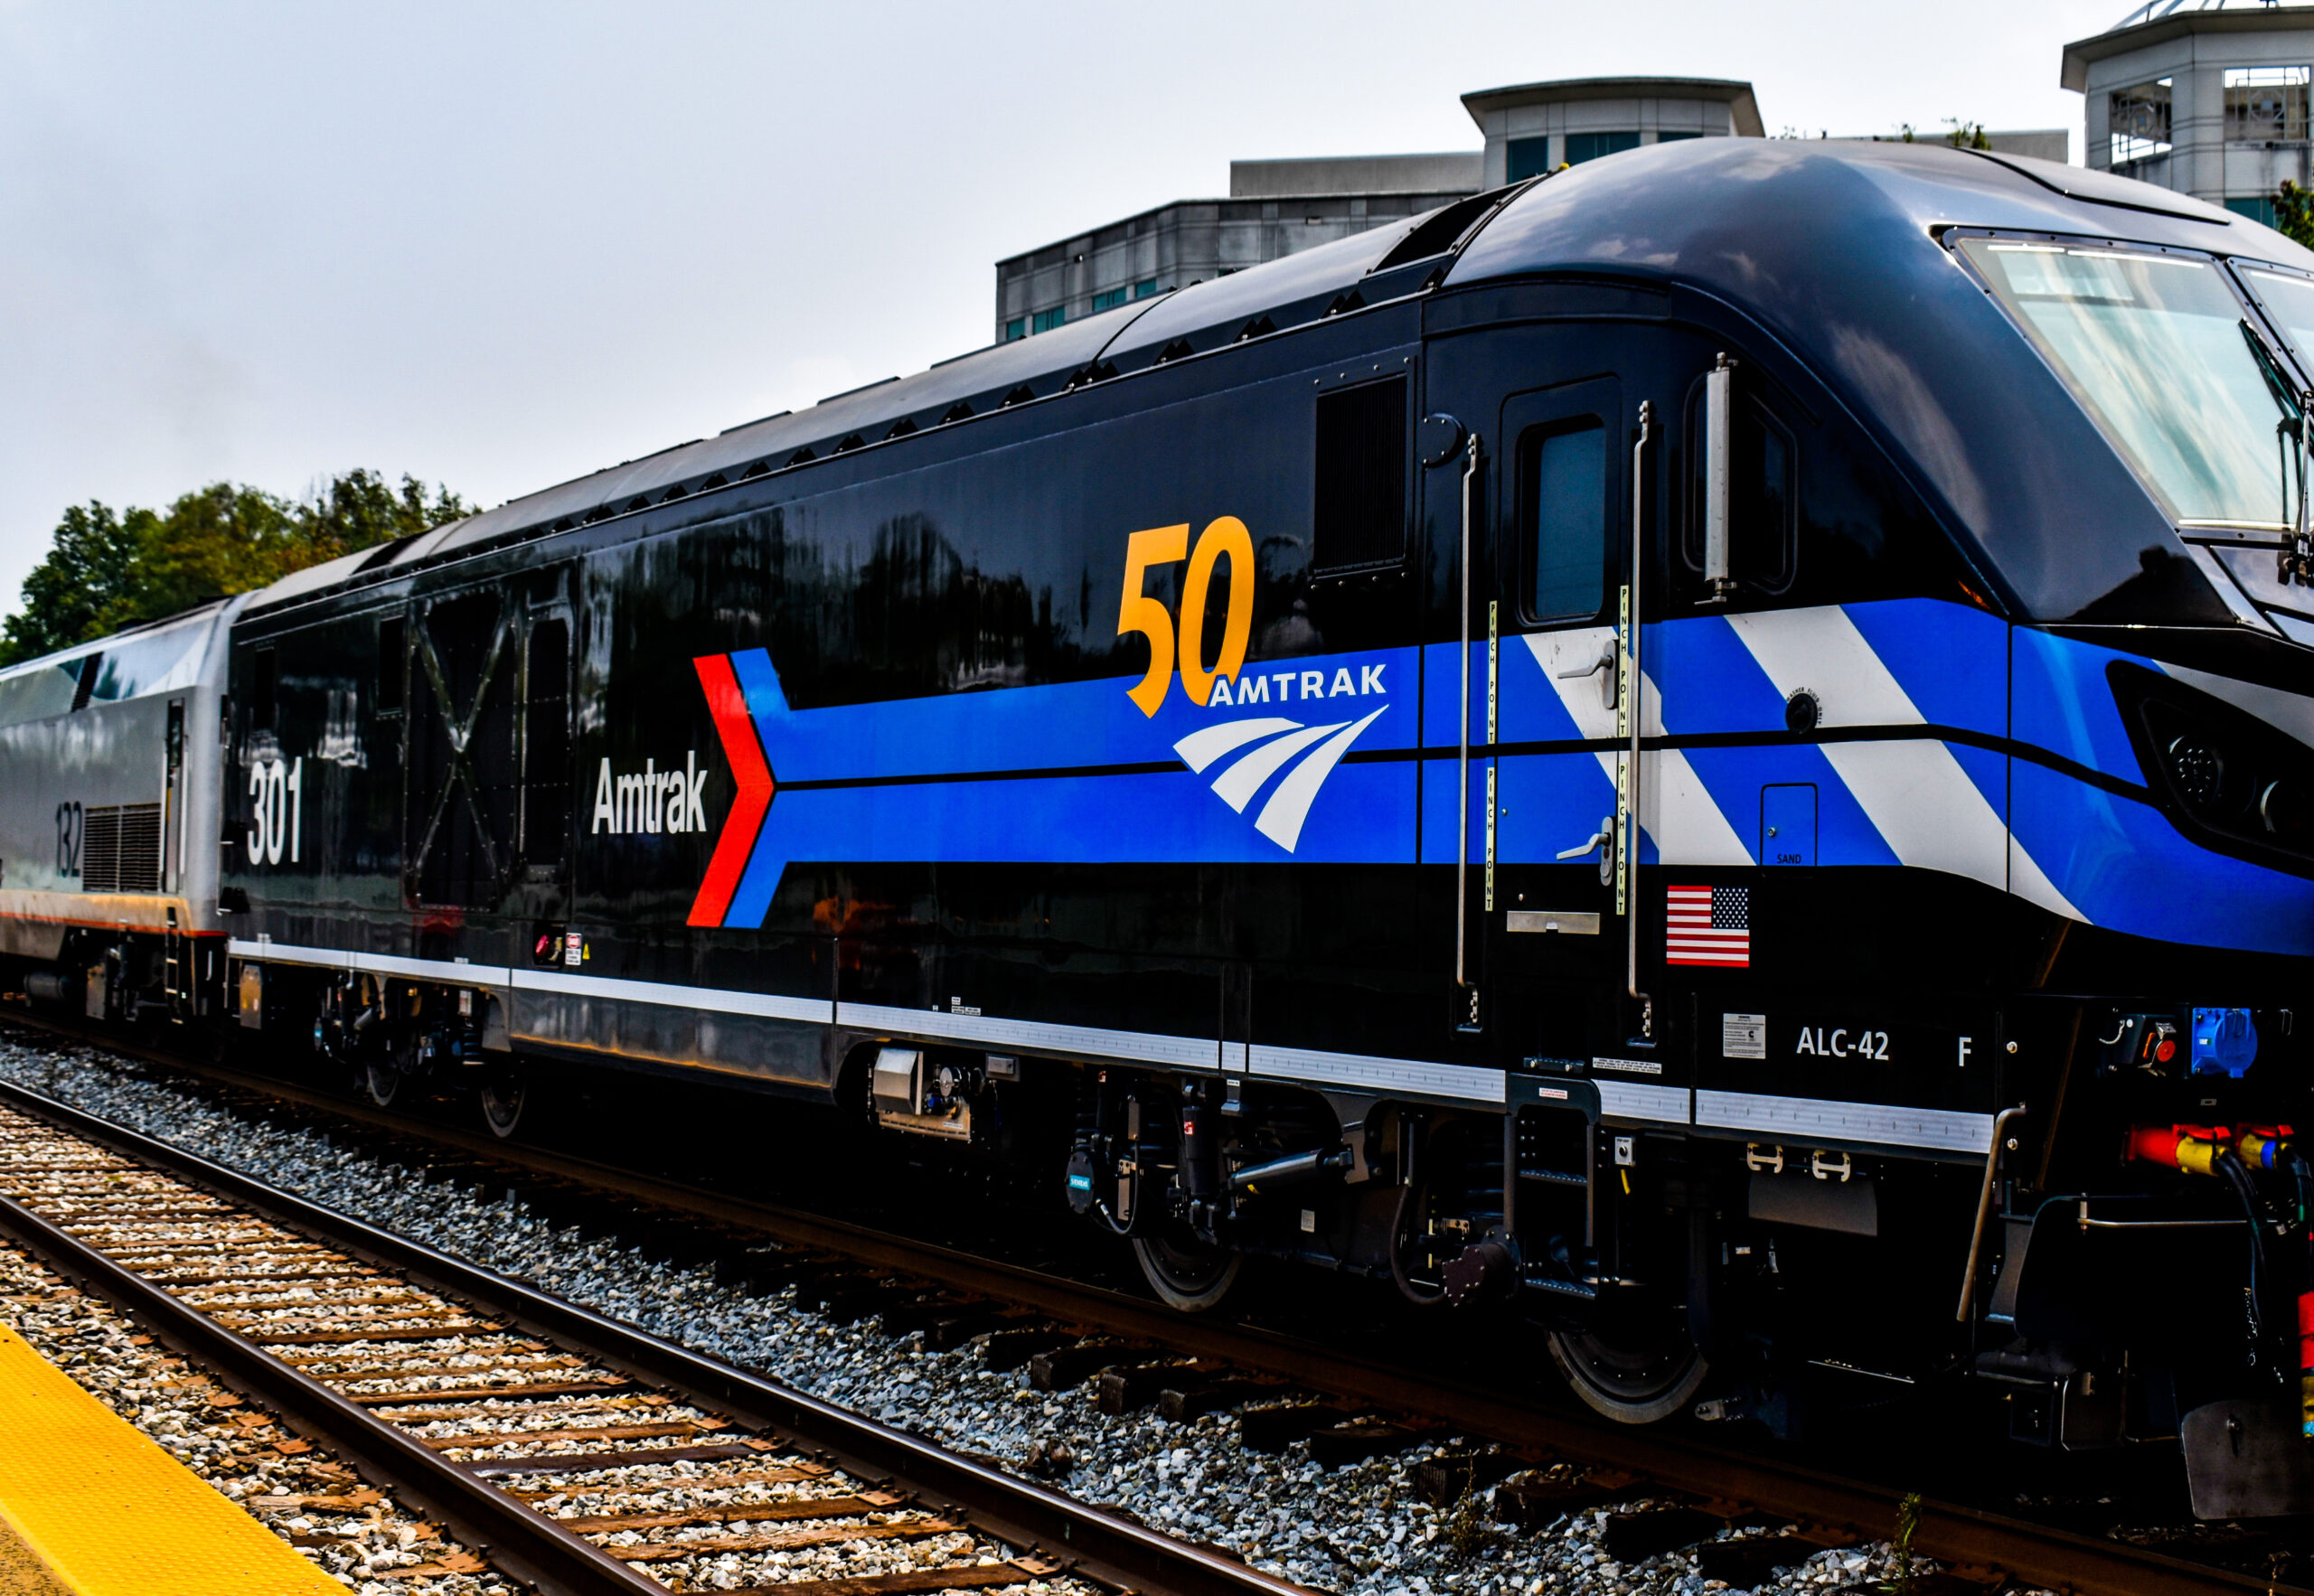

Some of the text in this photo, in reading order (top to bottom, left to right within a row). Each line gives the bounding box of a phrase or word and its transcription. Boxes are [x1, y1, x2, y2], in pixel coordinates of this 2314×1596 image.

[1117, 515, 1255, 719] 50
[1209, 664, 1387, 707] AMTRAK
[247, 756, 302, 866] 301
[592, 750, 708, 834] Amtrak
[55, 801, 82, 878] 132
[1776, 853, 1801, 865] SAND
[1796, 1027, 1889, 1061] ALC-42
[1958, 1037, 1971, 1066] F
